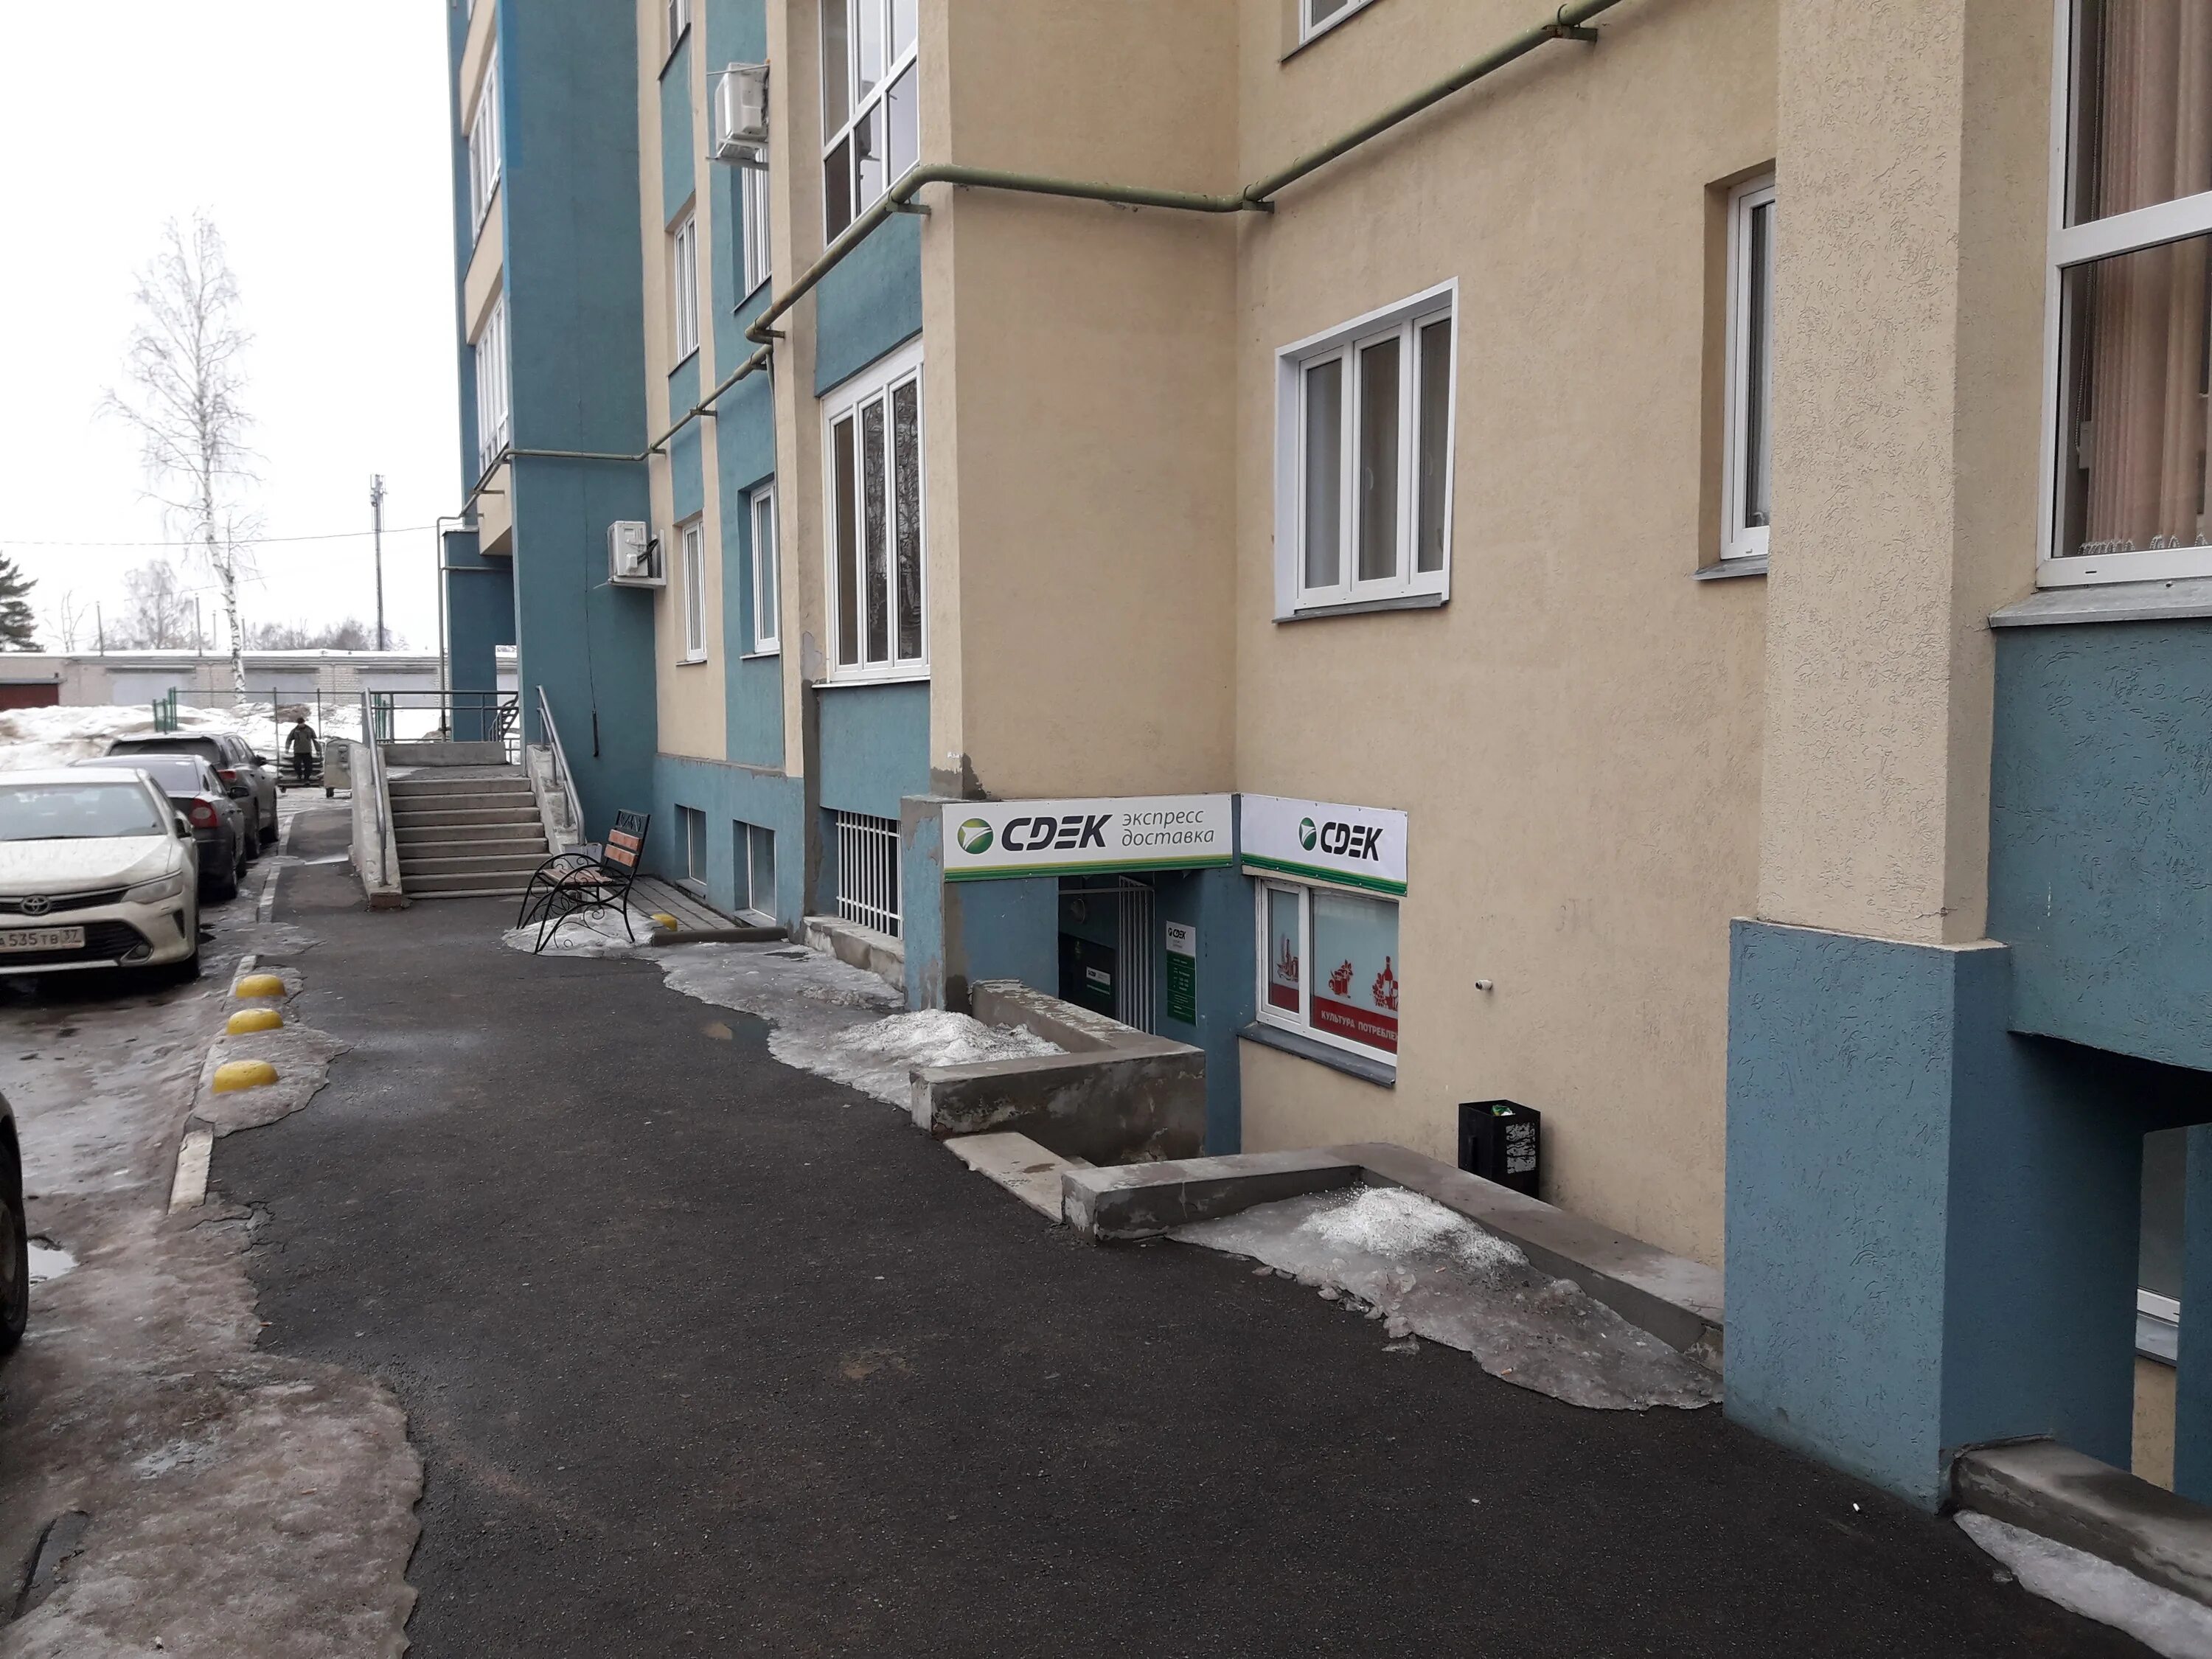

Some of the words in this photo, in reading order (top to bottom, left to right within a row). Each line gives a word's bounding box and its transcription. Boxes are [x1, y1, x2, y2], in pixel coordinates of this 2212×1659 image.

[1121, 810, 1204, 829] экспресс
[1001, 814, 1113, 852] CDEK
[1121, 829, 1215, 846] доставка
[1321, 821, 1384, 861] CDEK
[1321, 1010, 1355, 1029] КУЛЬТУРА
